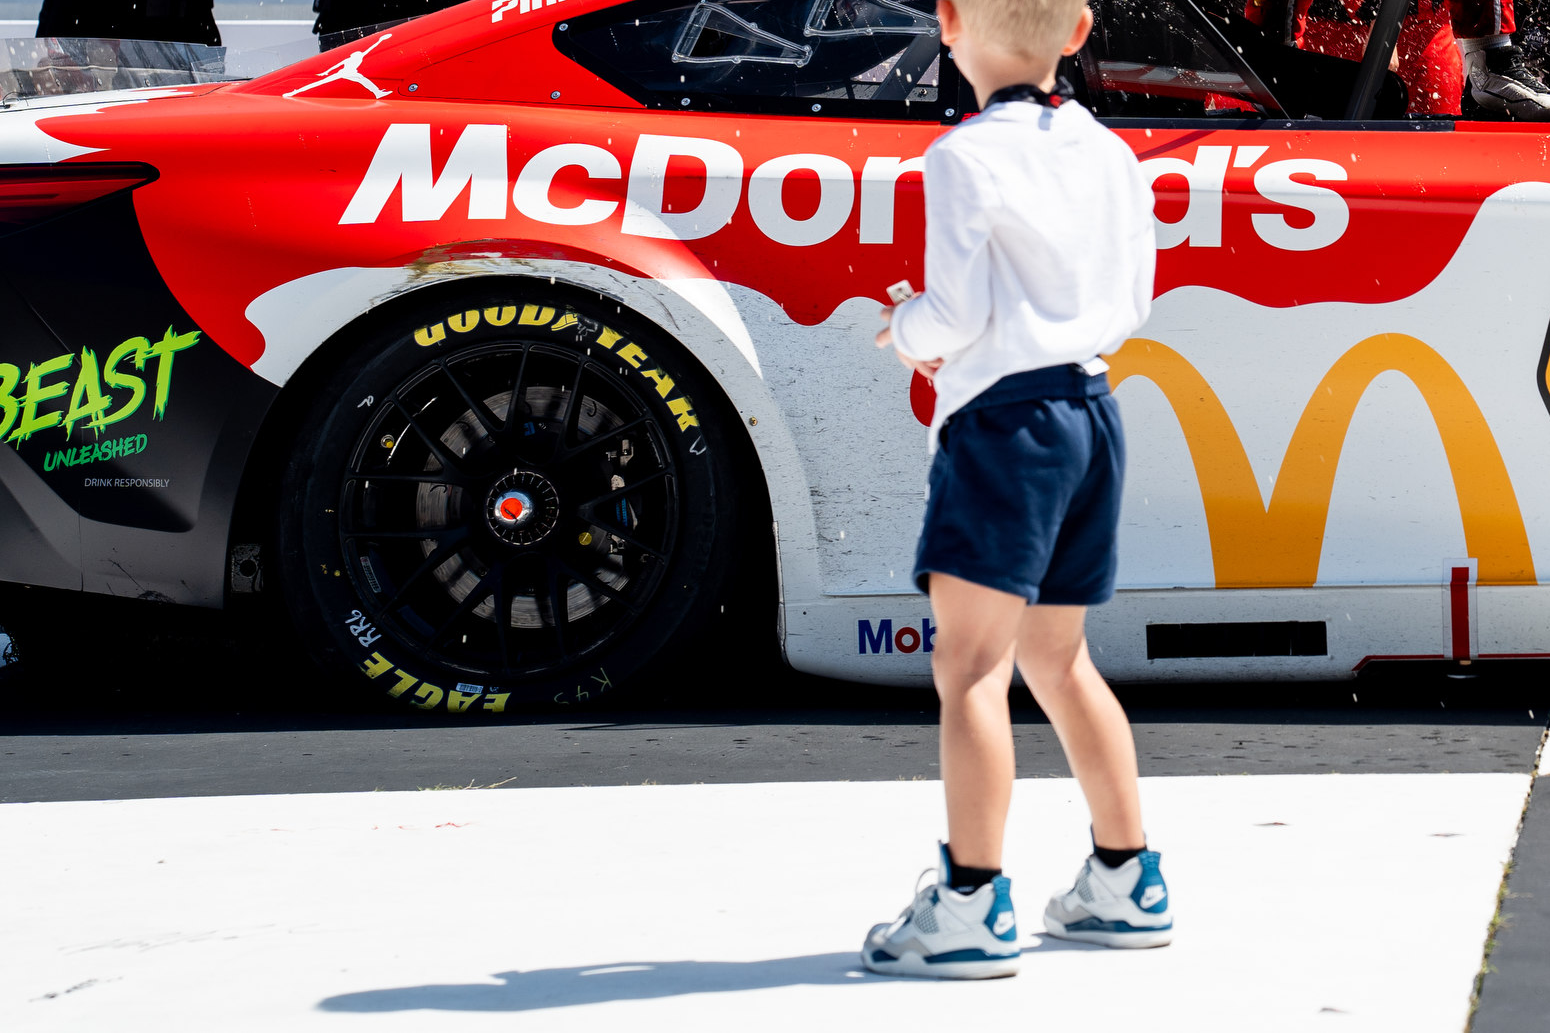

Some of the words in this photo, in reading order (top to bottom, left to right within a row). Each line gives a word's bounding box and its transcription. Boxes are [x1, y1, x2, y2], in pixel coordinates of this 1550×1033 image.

[0, 324, 202, 451] BEAST
[413, 303, 701, 433] GOODYEAR
[43, 433, 149, 472] UNLEASHED
[84, 477, 112, 487] DRINK
[114, 478, 170, 488] RESPONSIBLY
[857, 617, 937, 655] Mob
[361, 651, 512, 713] EAGLE
